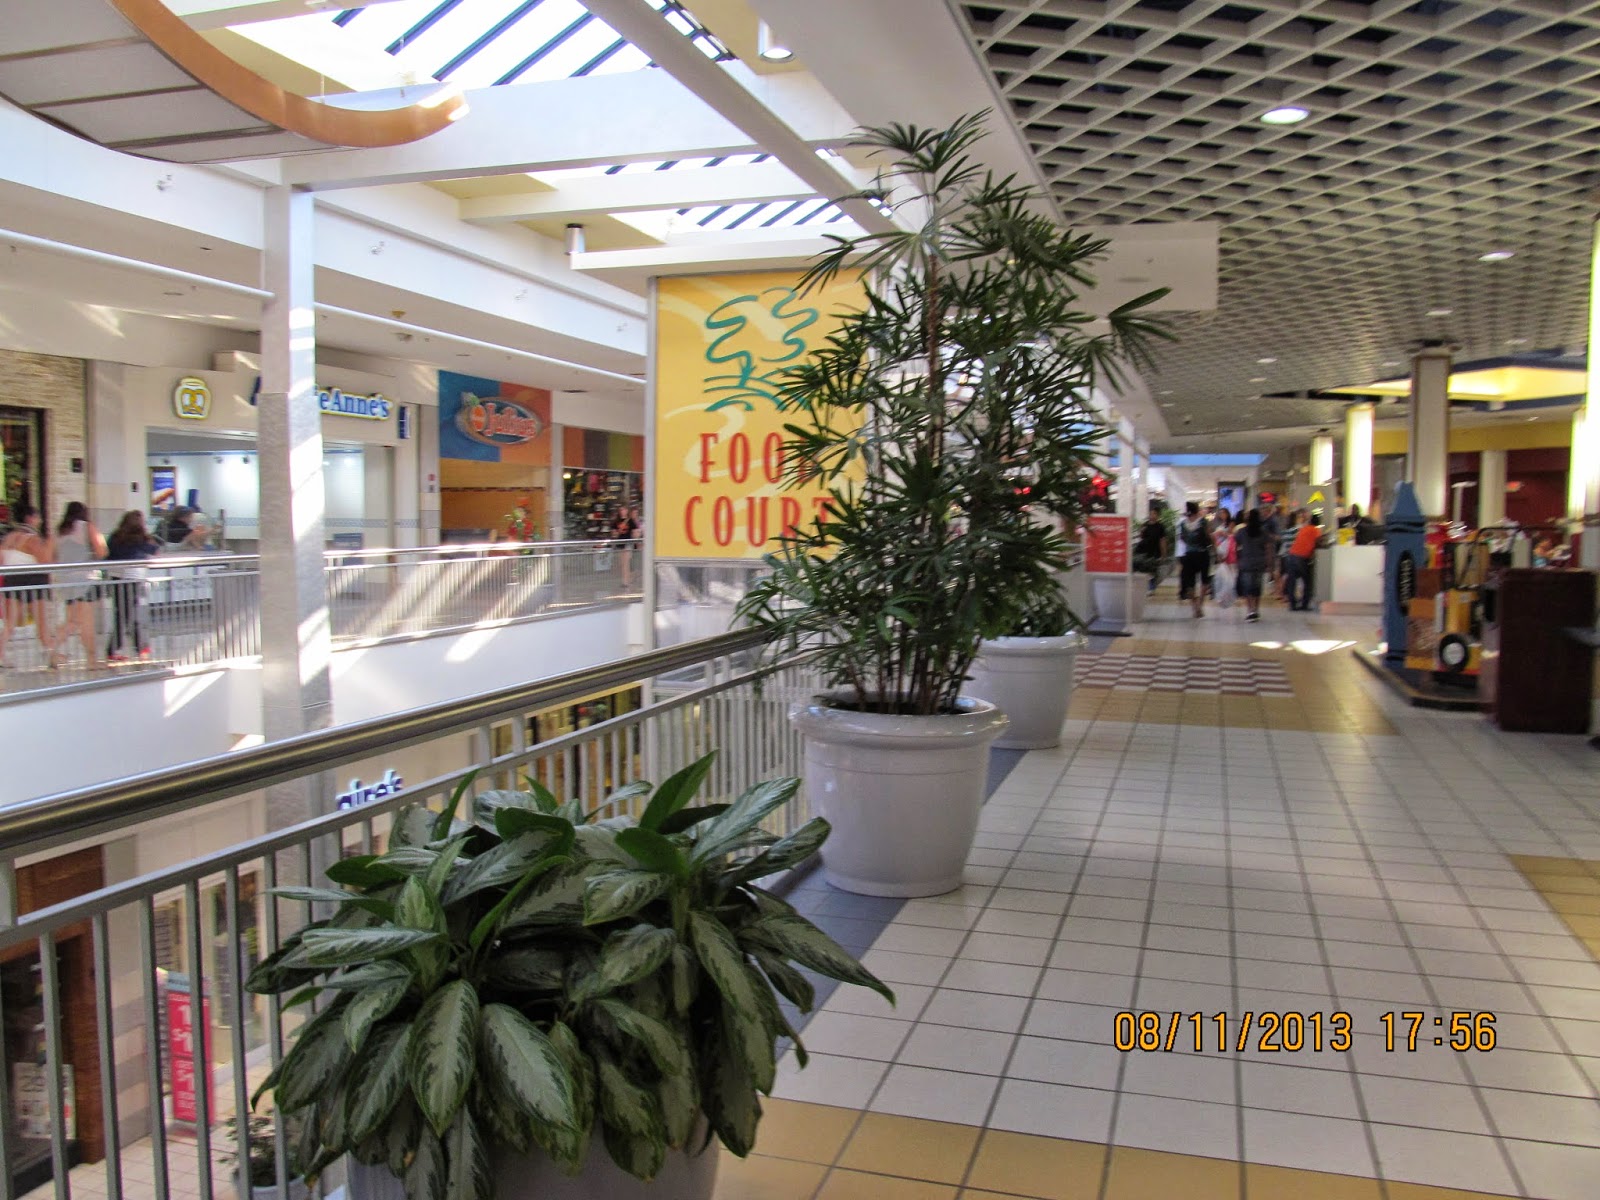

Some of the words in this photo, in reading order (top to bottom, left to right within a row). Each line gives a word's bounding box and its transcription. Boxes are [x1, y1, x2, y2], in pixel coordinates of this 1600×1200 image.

[331, 388, 391, 419] Anne's
[699, 431, 818, 484] FOO
[684, 495, 837, 548] COURT
